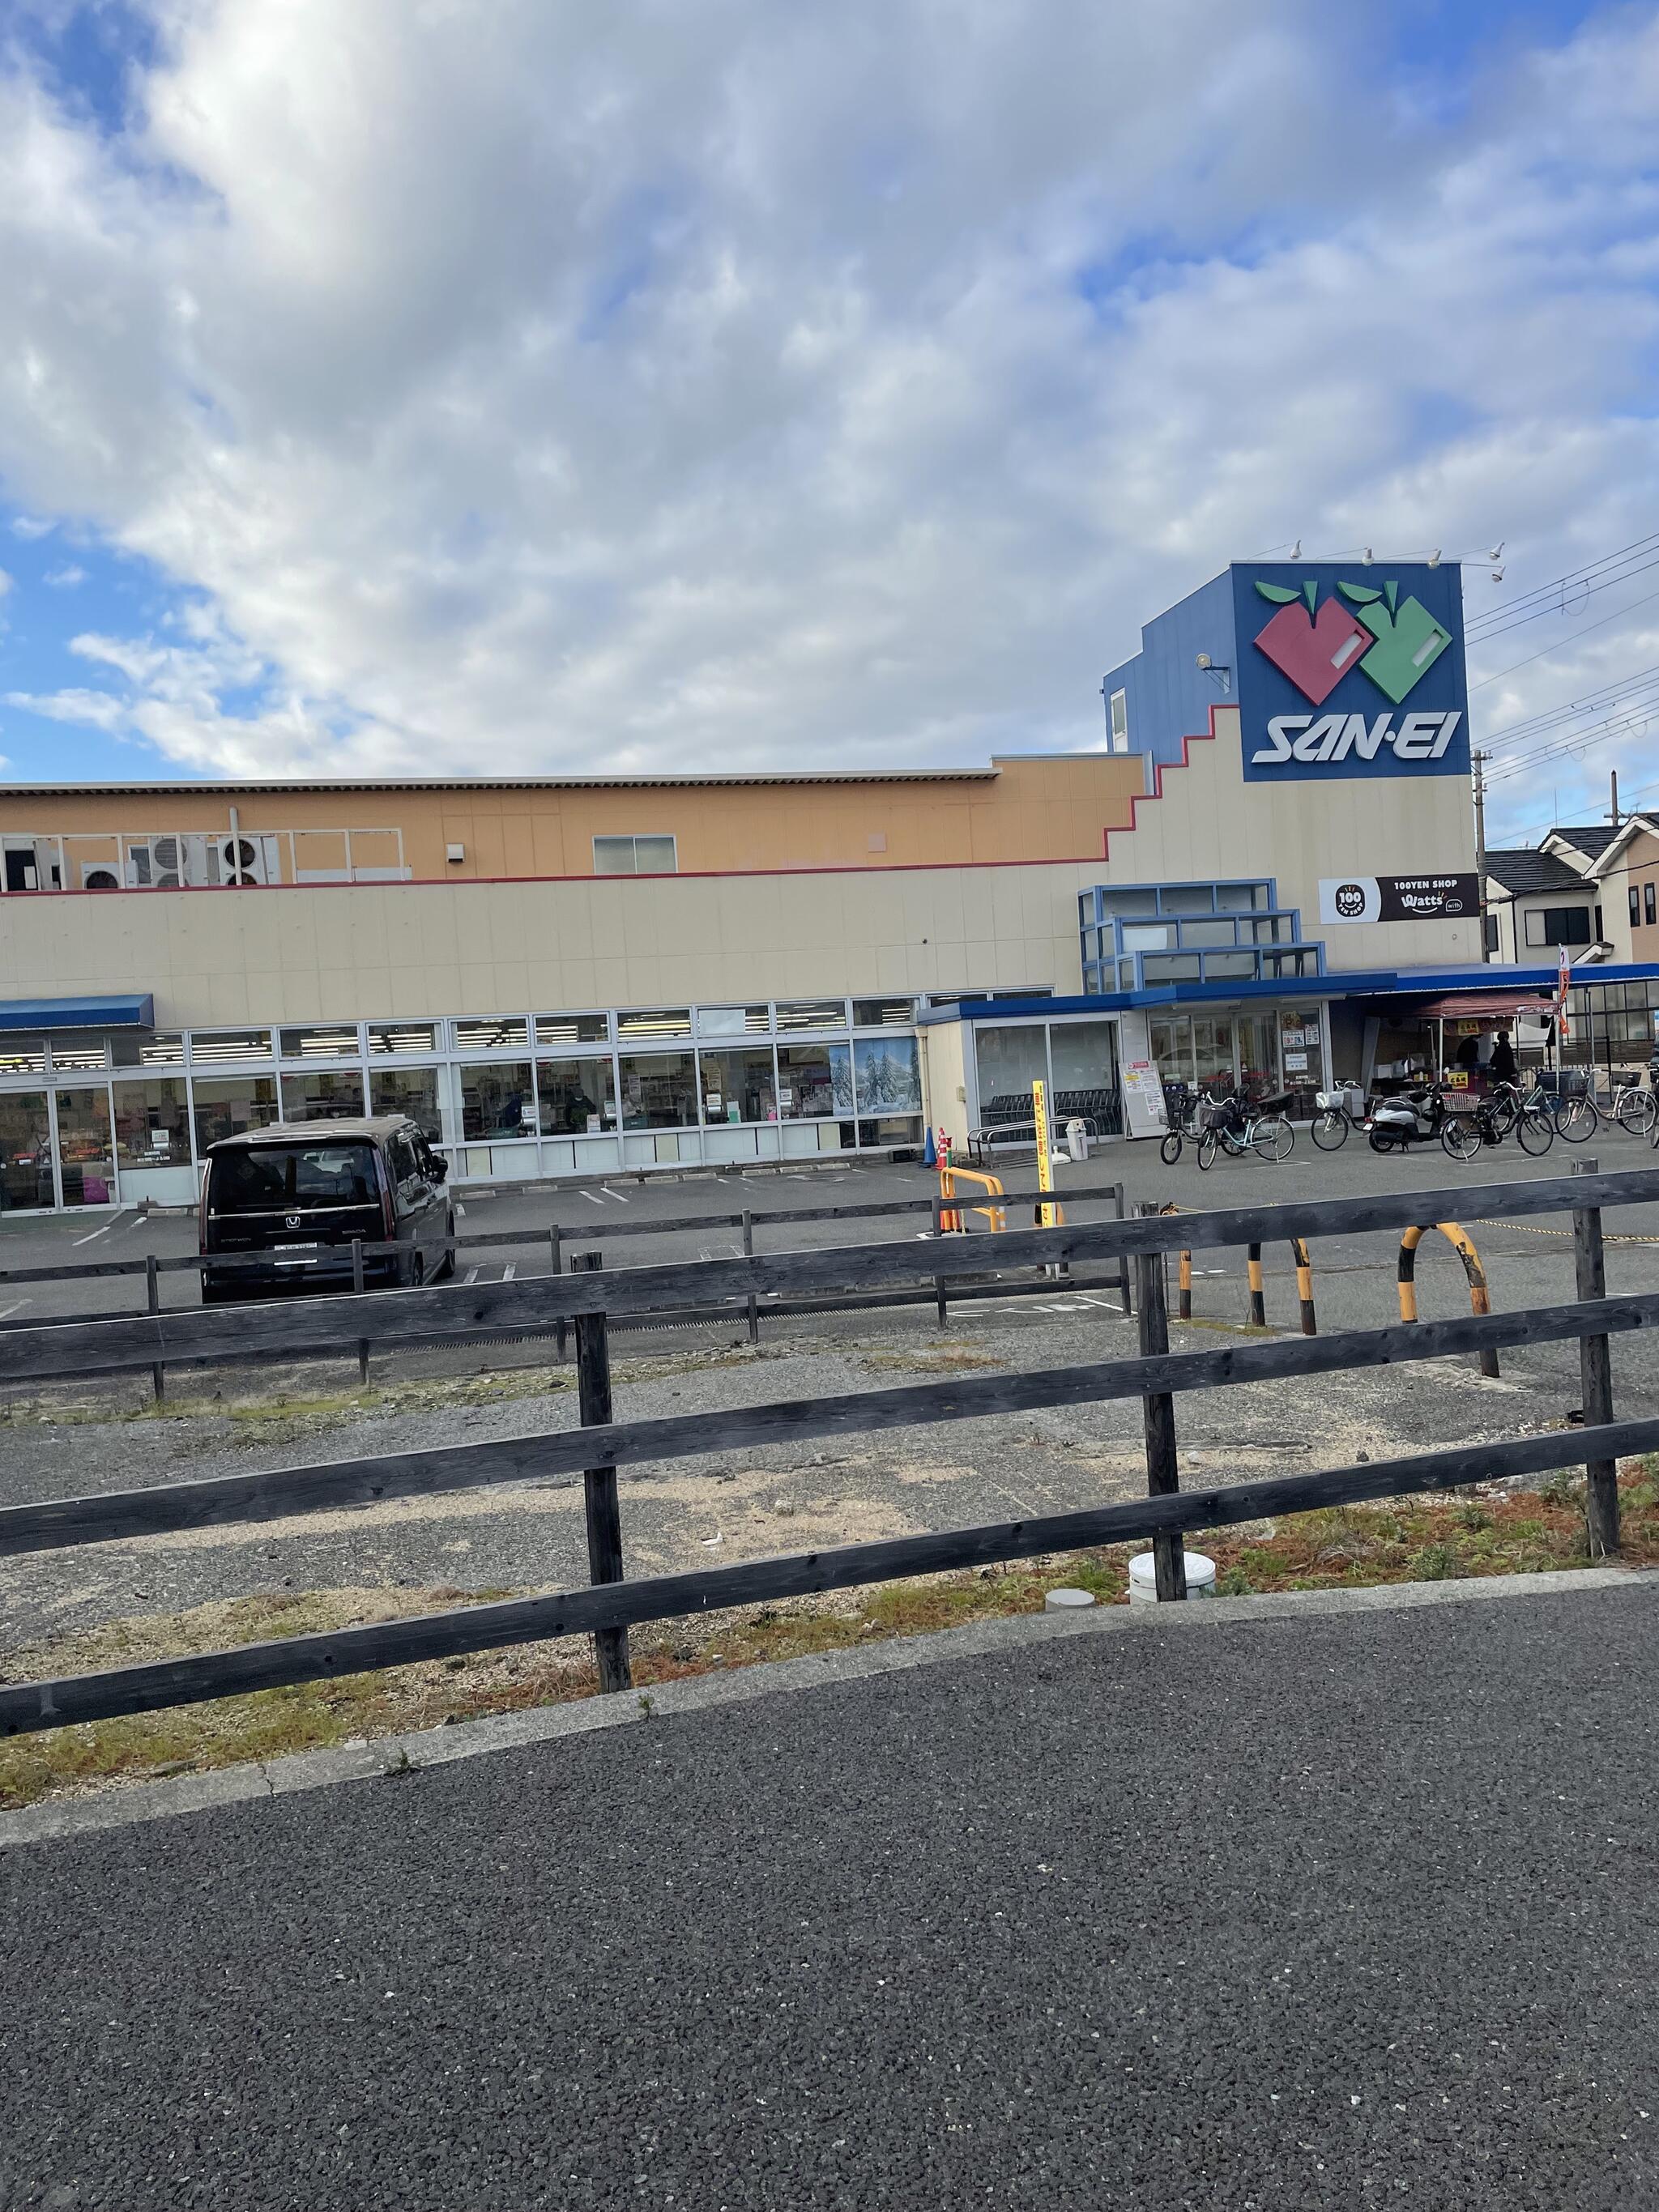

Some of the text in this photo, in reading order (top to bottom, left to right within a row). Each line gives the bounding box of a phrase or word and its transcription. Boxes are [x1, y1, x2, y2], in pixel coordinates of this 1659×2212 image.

[1394, 880, 1457, 890] 100YEN SHOP
[1339, 892, 1362, 903] 100
[1401, 893, 1443, 908] Watts
[1338, 902, 1363, 915] YEN SHOP
